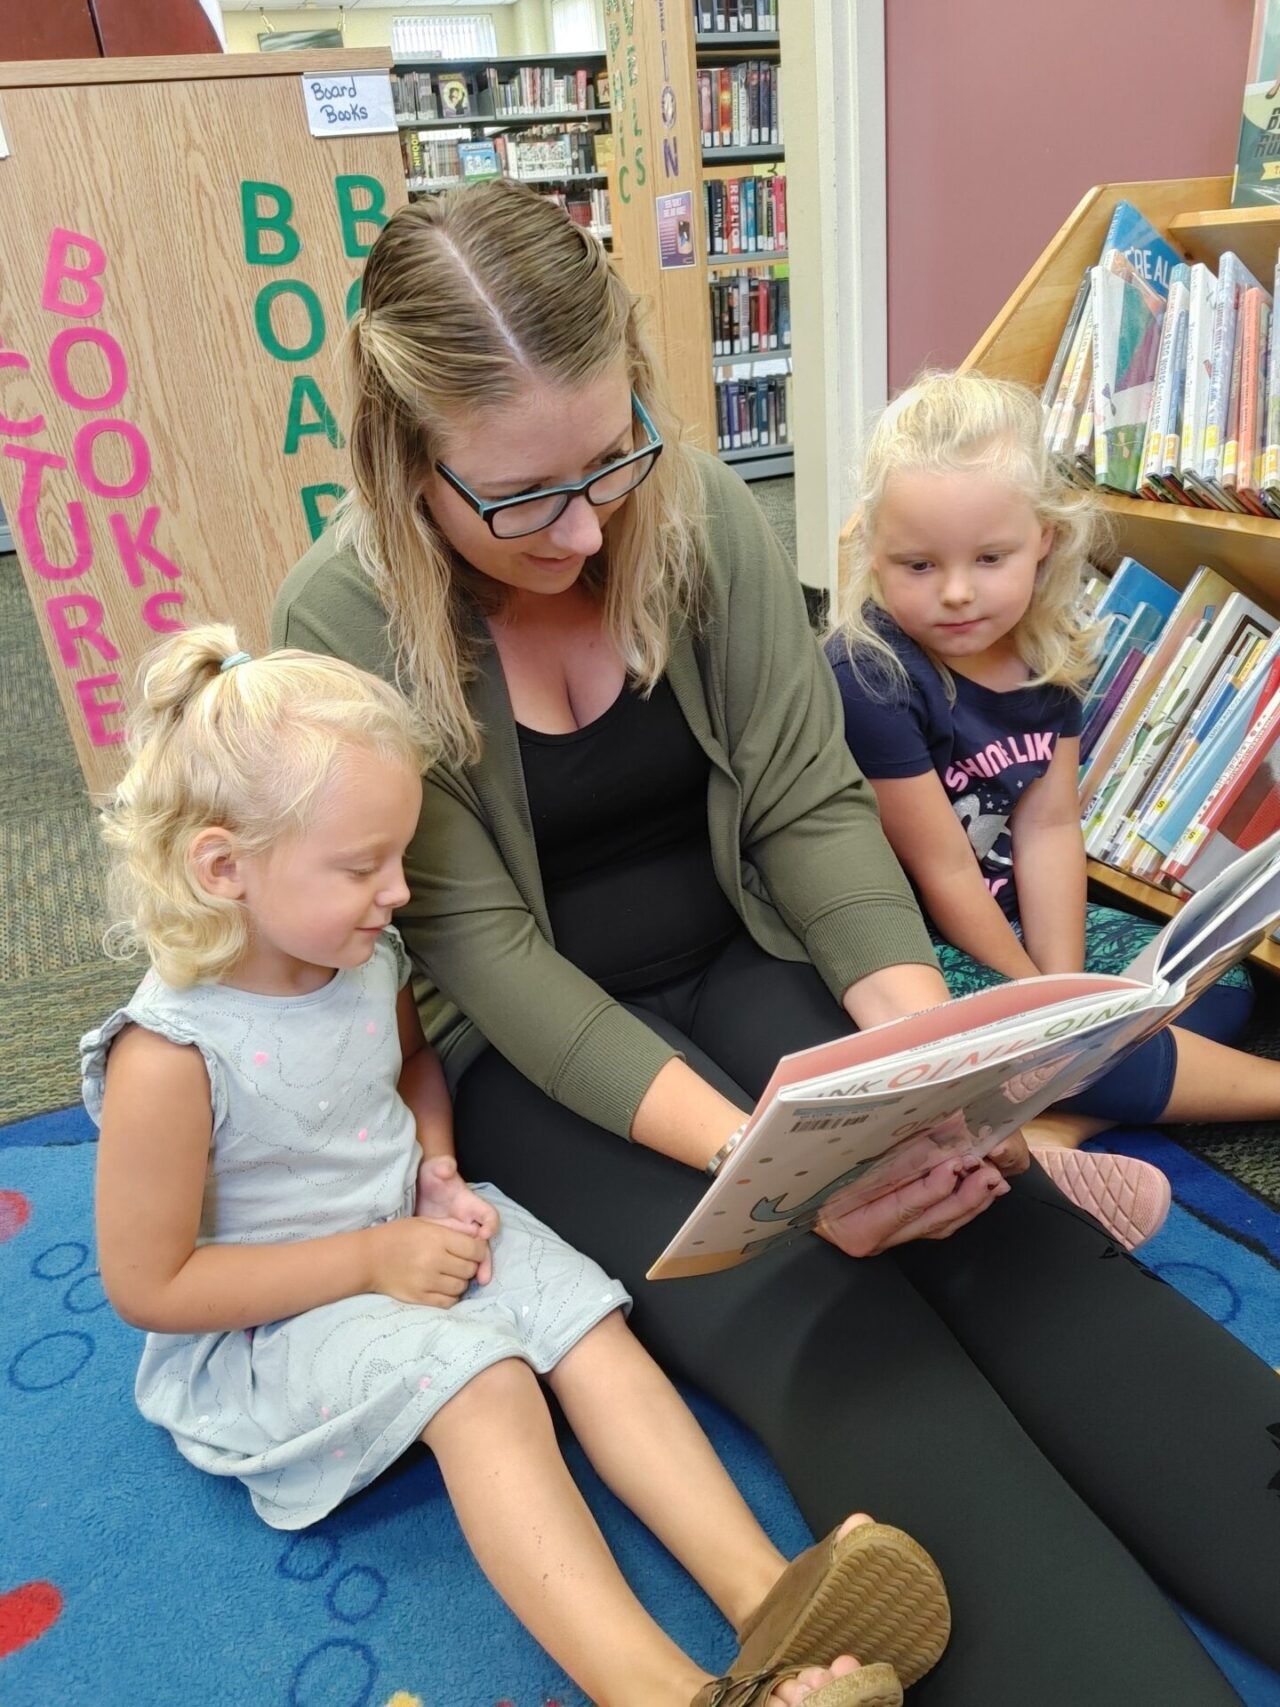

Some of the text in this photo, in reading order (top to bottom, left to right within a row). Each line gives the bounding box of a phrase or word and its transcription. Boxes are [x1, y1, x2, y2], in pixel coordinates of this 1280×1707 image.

[311, 75, 357, 101] Board
[320, 104, 368, 124] Books
[240, 180, 348, 544] BOAR
[1007, 732, 1060, 763] LIK
[1043, 999, 1141, 1039] OINK
